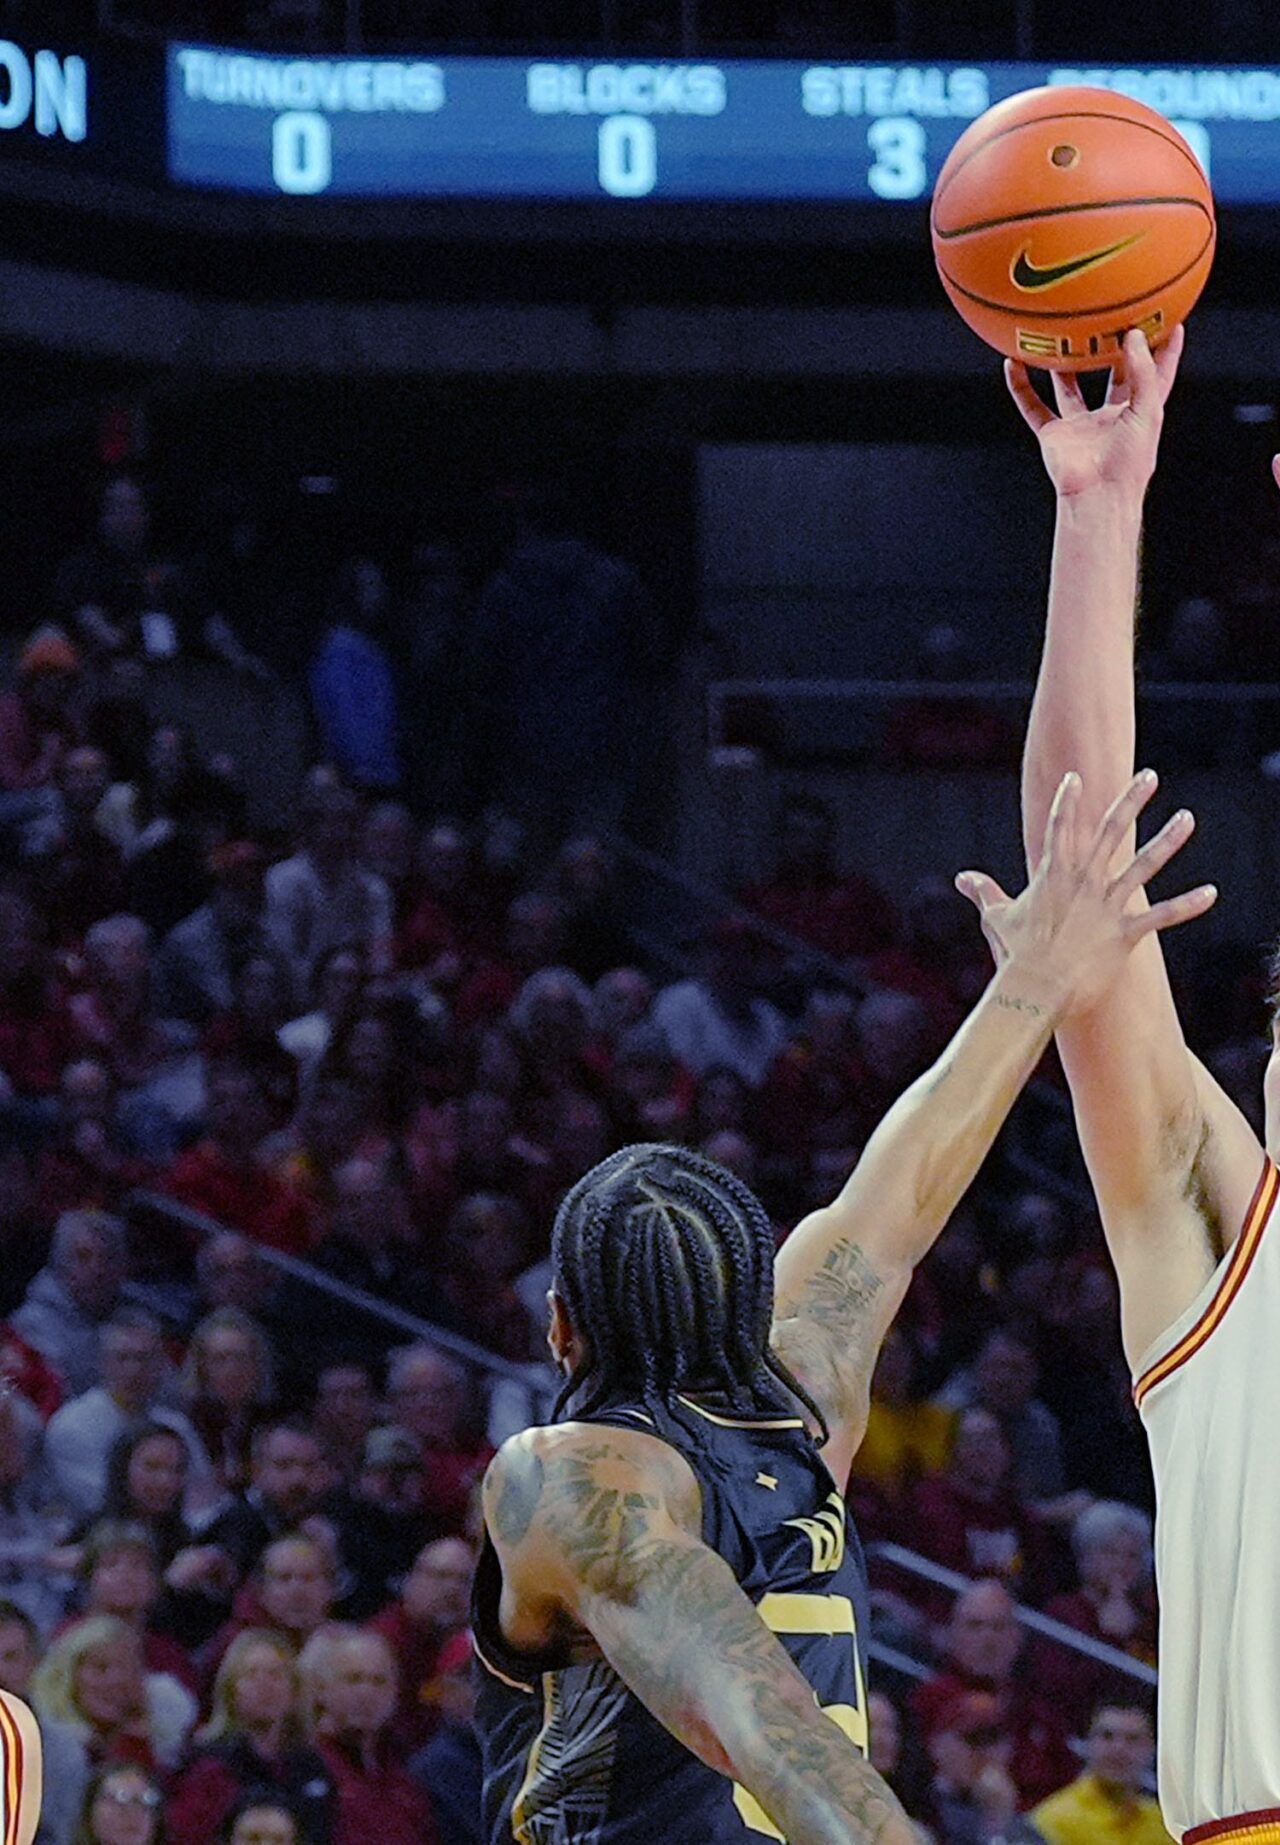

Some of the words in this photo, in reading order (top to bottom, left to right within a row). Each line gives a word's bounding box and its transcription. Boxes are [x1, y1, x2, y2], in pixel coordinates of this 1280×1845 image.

[178, 49, 446, 112] TURNOVERS
[526, 63, 727, 115] BLOCKS
[801, 66, 990, 117] STEALS
[272, 111, 332, 195] 0
[599, 114, 657, 198] 0
[867, 116, 926, 199] 3
